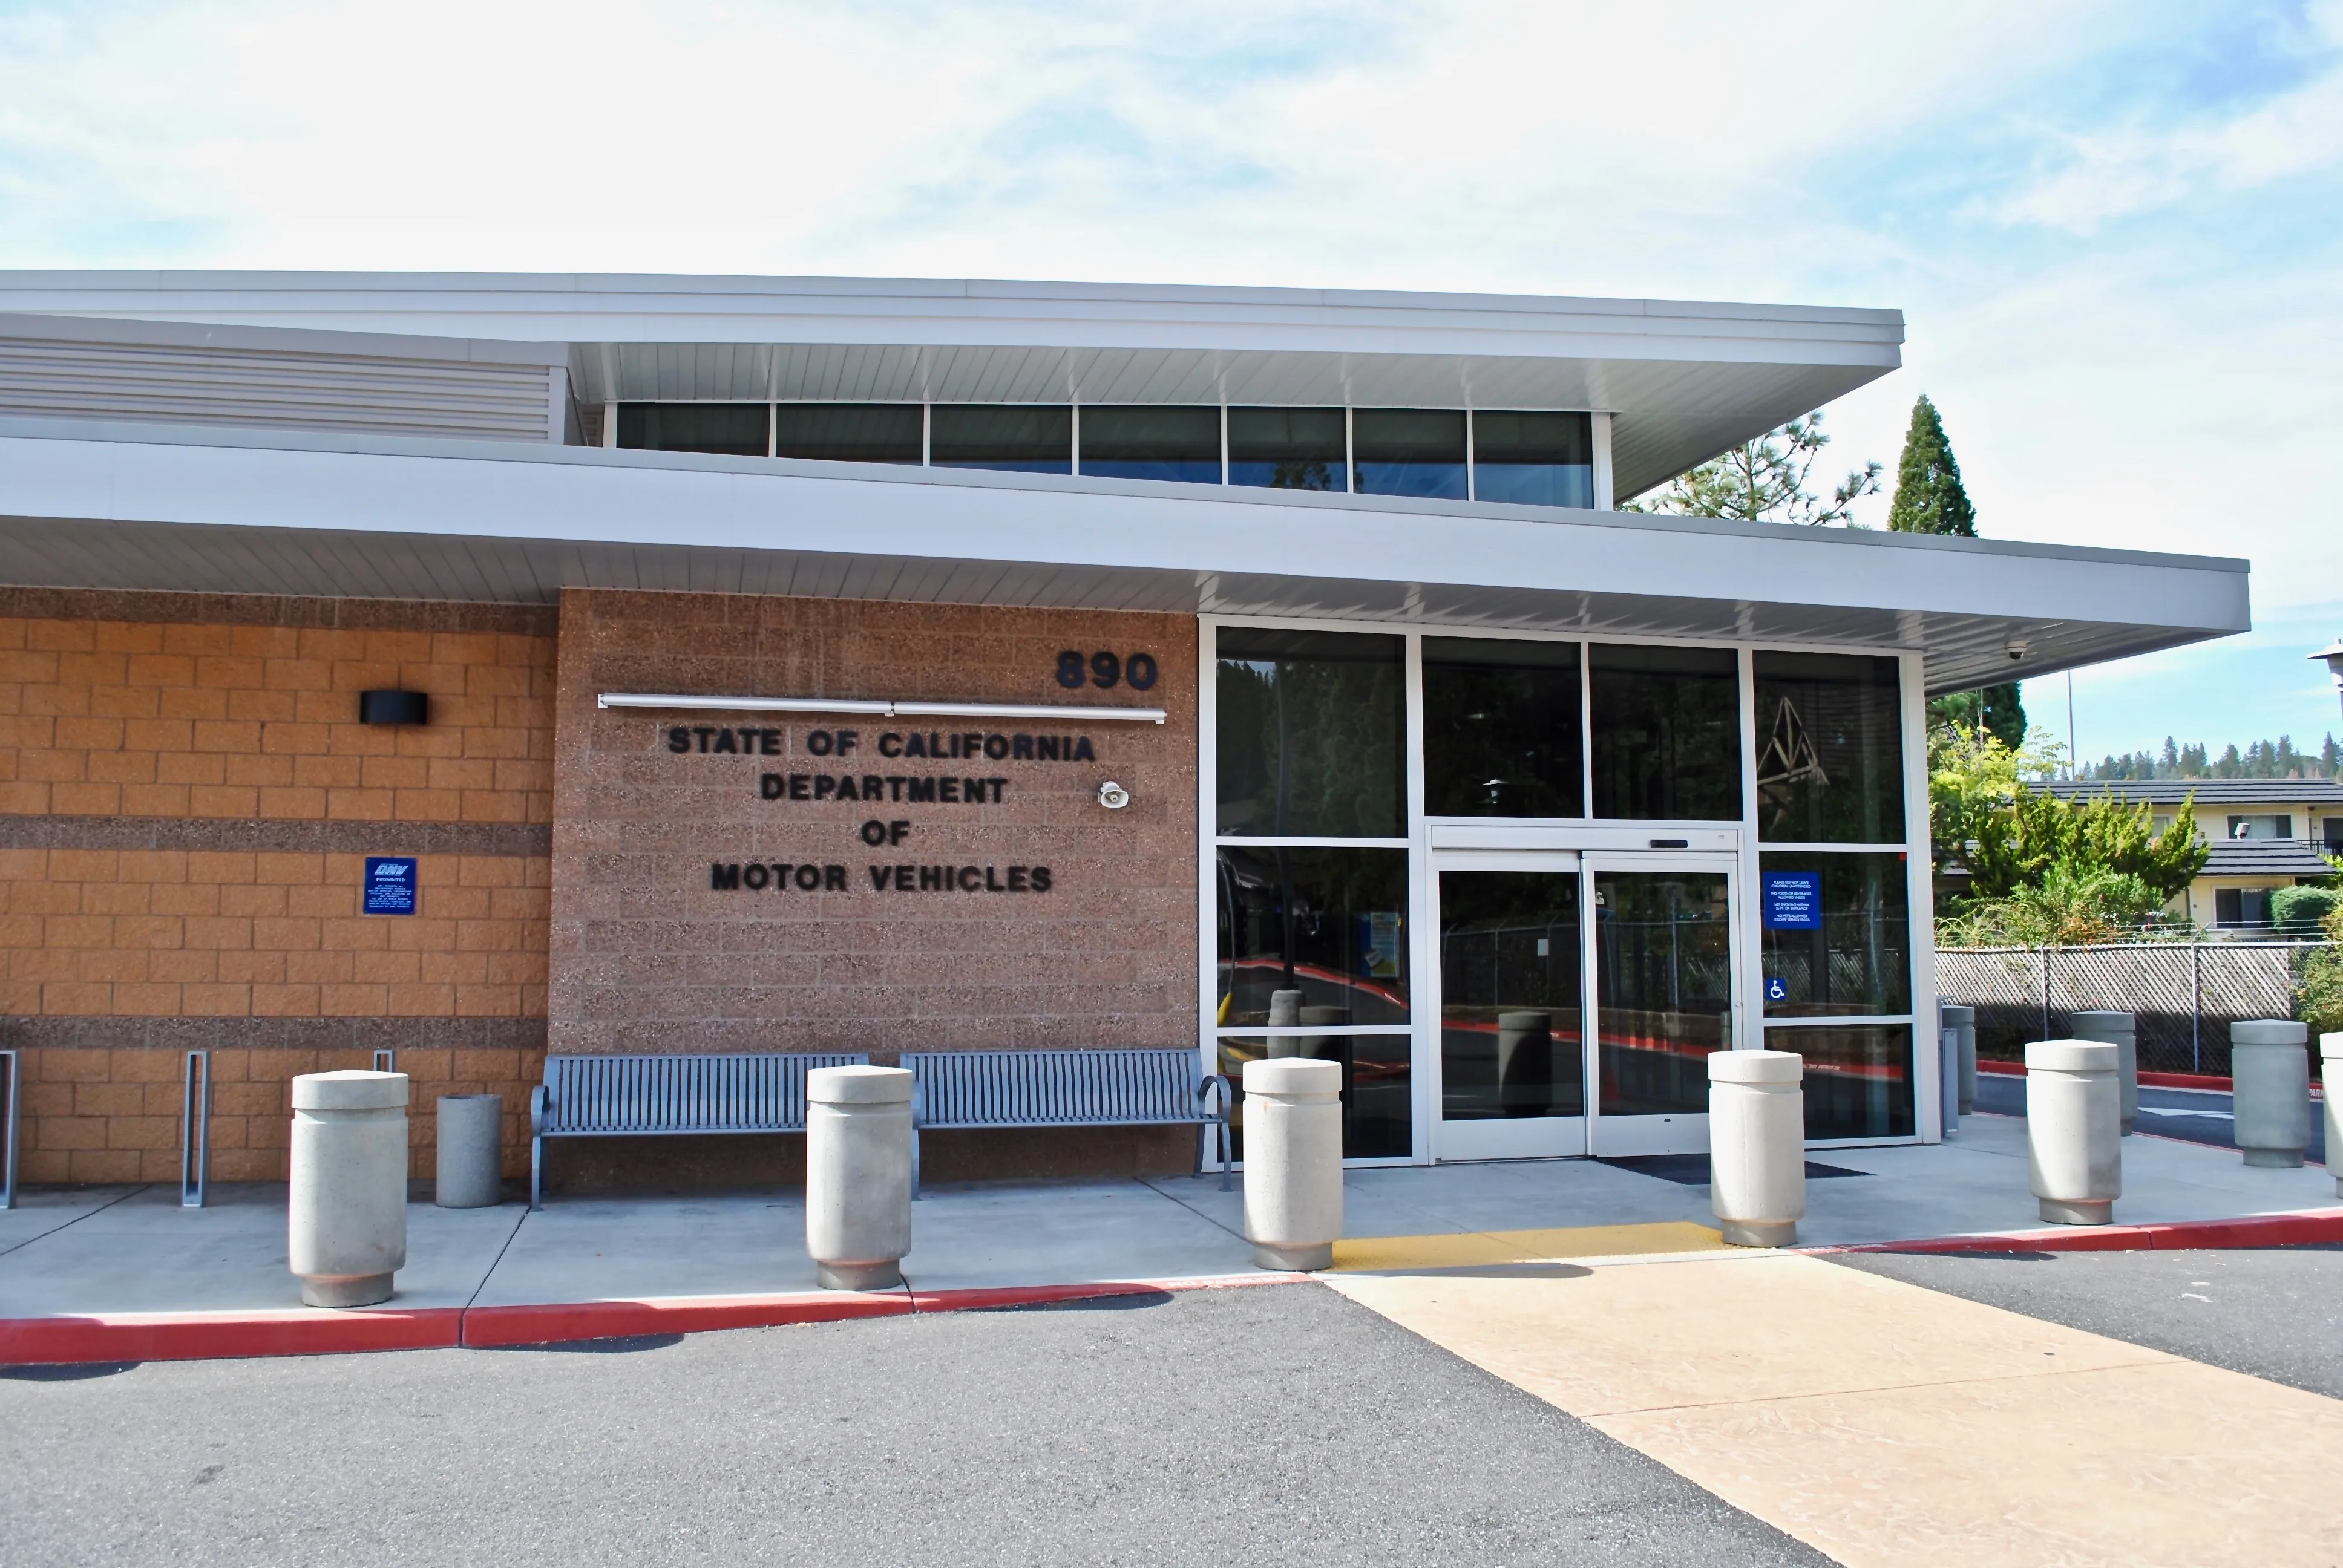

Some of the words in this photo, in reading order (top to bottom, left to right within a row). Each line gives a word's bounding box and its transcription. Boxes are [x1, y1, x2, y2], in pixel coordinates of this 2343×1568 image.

[1057, 650, 1158, 691] 890
[668, 727, 782, 754] STATE
[807, 730, 858, 756] OF
[879, 731, 1095, 762] CALIFORNIA
[761, 773, 1008, 803] DEPARTMENT
[861, 820, 911, 846] OF
[375, 865, 408, 875] DMV
[711, 863, 847, 892] MOTOR
[869, 865, 1052, 892] VEHICLES
[1201, 1275, 1291, 1285] PARKING
